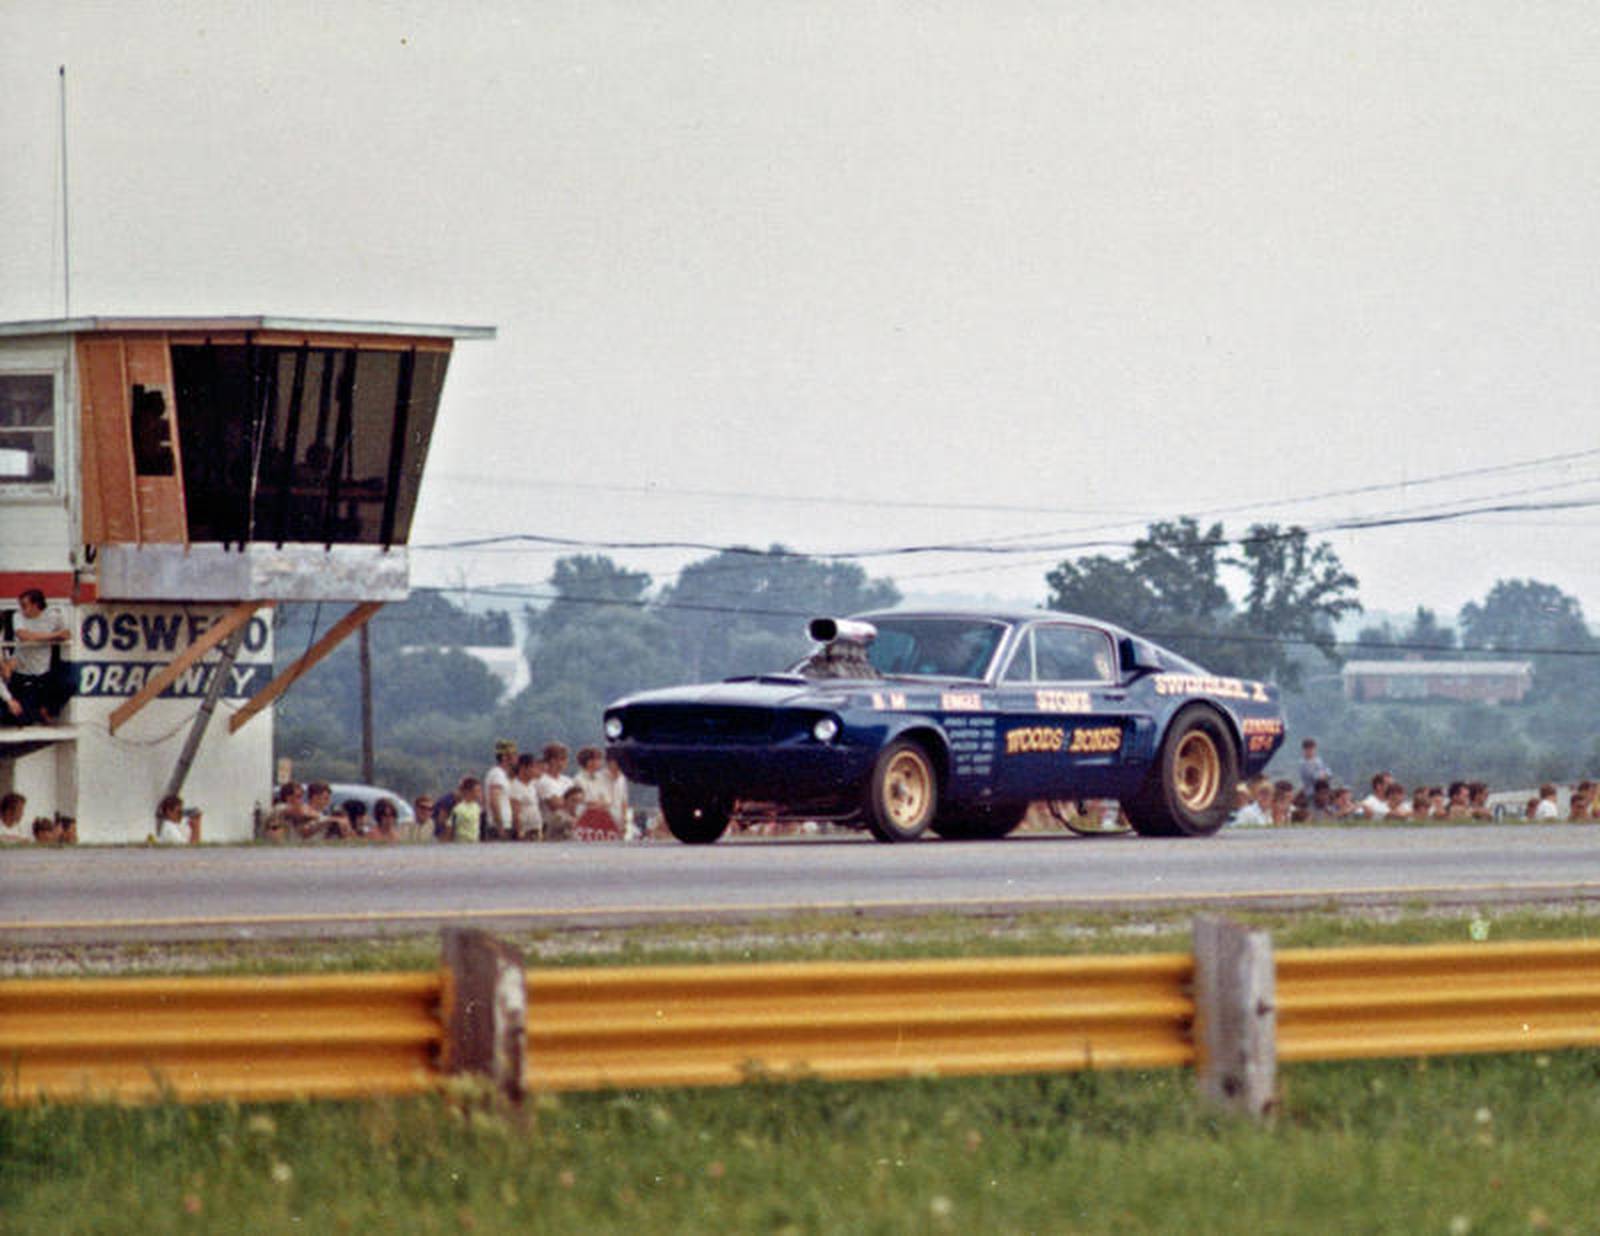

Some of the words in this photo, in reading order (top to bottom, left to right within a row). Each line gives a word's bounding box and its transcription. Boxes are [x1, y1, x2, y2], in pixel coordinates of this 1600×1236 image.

[81, 613, 268, 651] OSWEO
[79, 664, 255, 695] DRAWY
[1005, 727, 1063, 754] WOODS
